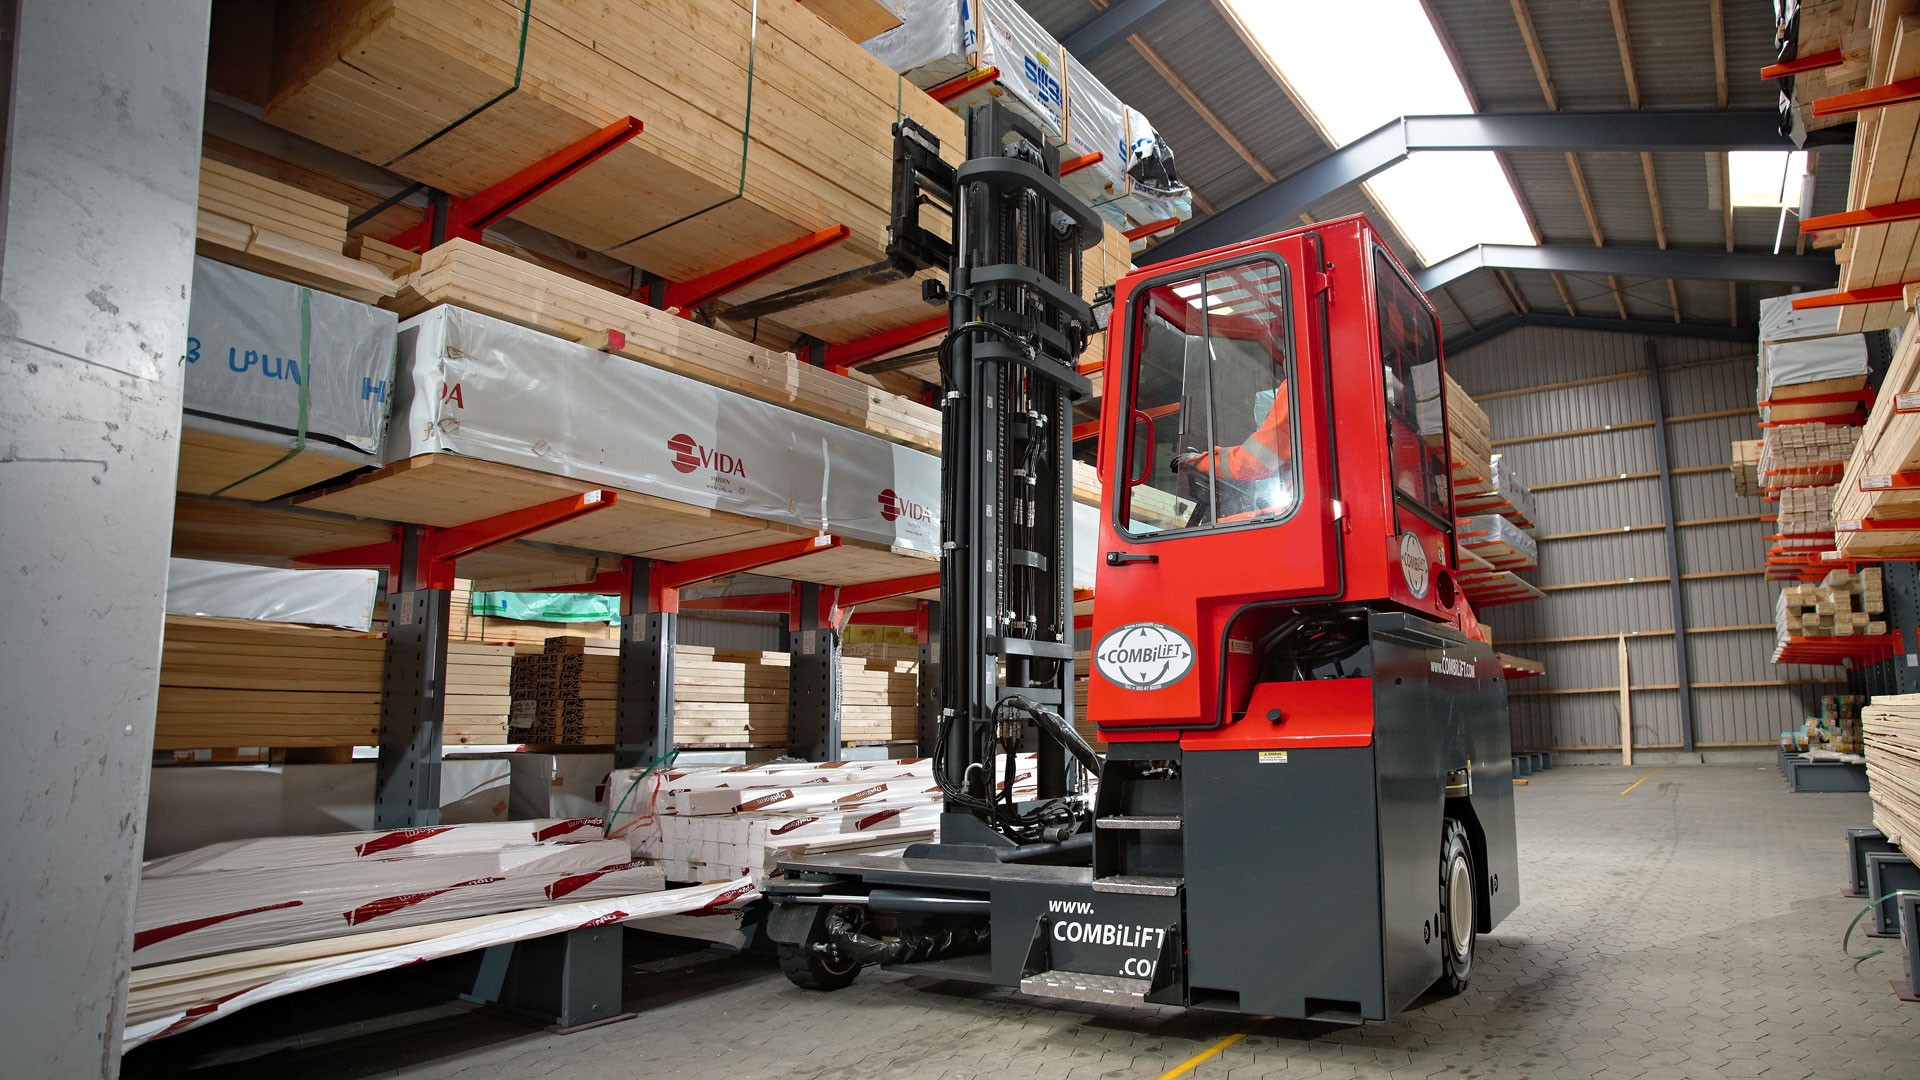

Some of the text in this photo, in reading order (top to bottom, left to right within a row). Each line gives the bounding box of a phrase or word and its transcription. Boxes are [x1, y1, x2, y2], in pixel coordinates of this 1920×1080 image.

[699, 444, 746, 478] VIDA
[898, 497, 931, 523] VIDA
[756, 790, 788, 806] Optiform
[1048, 900, 1095, 915] www.
[1118, 957, 1157, 978] .CO
